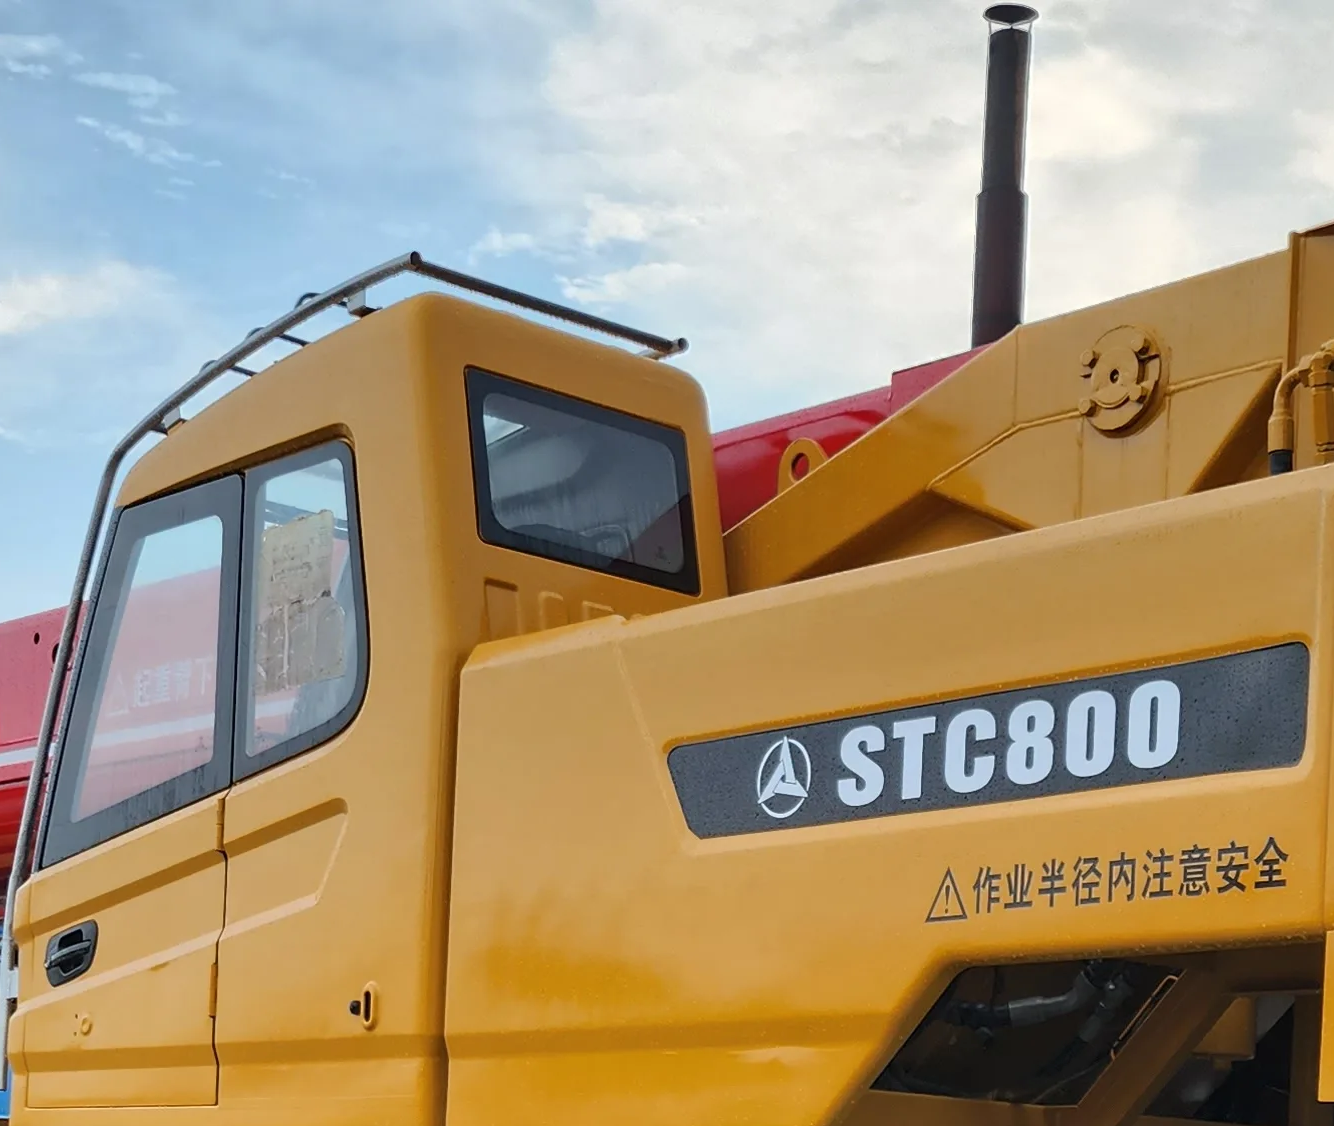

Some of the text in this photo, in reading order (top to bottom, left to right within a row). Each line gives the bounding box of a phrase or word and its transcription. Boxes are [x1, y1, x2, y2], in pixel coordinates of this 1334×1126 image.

[838, 680, 1181, 806] STC800
[972, 836, 1289, 914] 作业半径内注意安全
